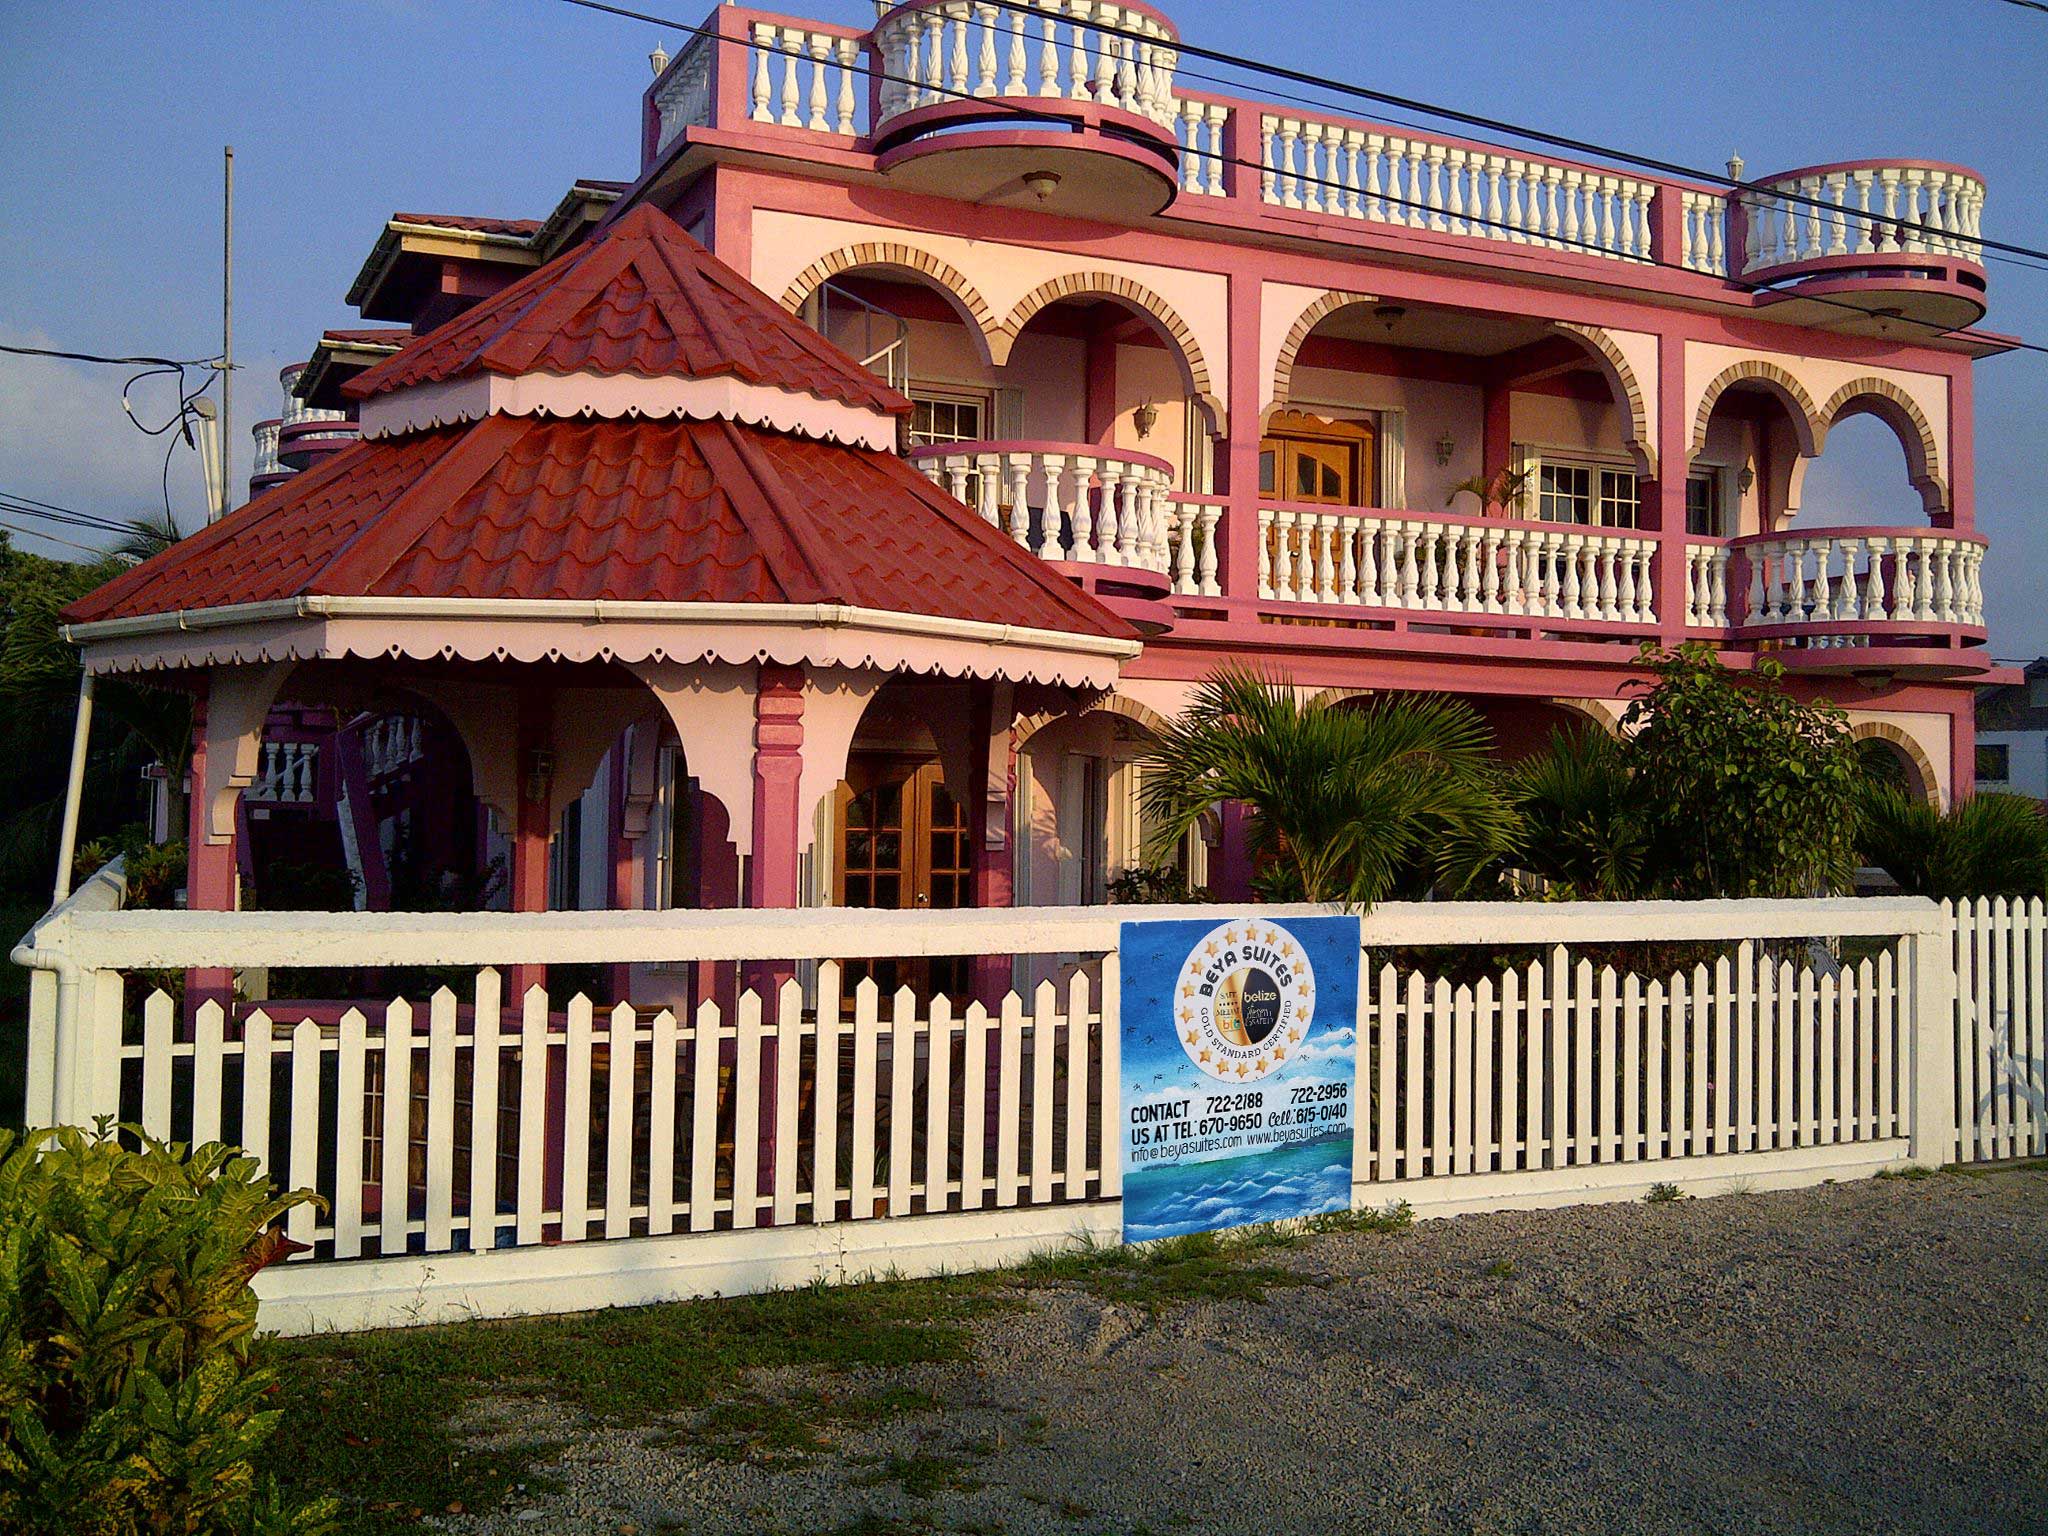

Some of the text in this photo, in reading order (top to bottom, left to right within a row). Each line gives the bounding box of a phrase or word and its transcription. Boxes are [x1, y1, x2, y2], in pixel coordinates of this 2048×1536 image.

[1199, 945, 1293, 998] BEYA SUITES
[1244, 990, 1277, 1003] belize
[1200, 1007, 1214, 1038] GOLD
[1211, 1037, 1261, 1059] STANDARD
[1263, 1000, 1292, 1051] CERTIFIED
[1206, 1092, 1263, 1114] 722-2188
[1290, 1082, 1348, 1105] 722-2956
[1131, 1100, 1190, 1124] CONTACT
[1131, 1128, 1150, 1146] US
[1153, 1124, 1170, 1143] AT
[1172, 1120, 1197, 1140] TEL:
[1199, 1113, 1262, 1136] 670-9650
[1131, 1122, 1347, 1162] info@beyasuites.com www.beyasuites.com
